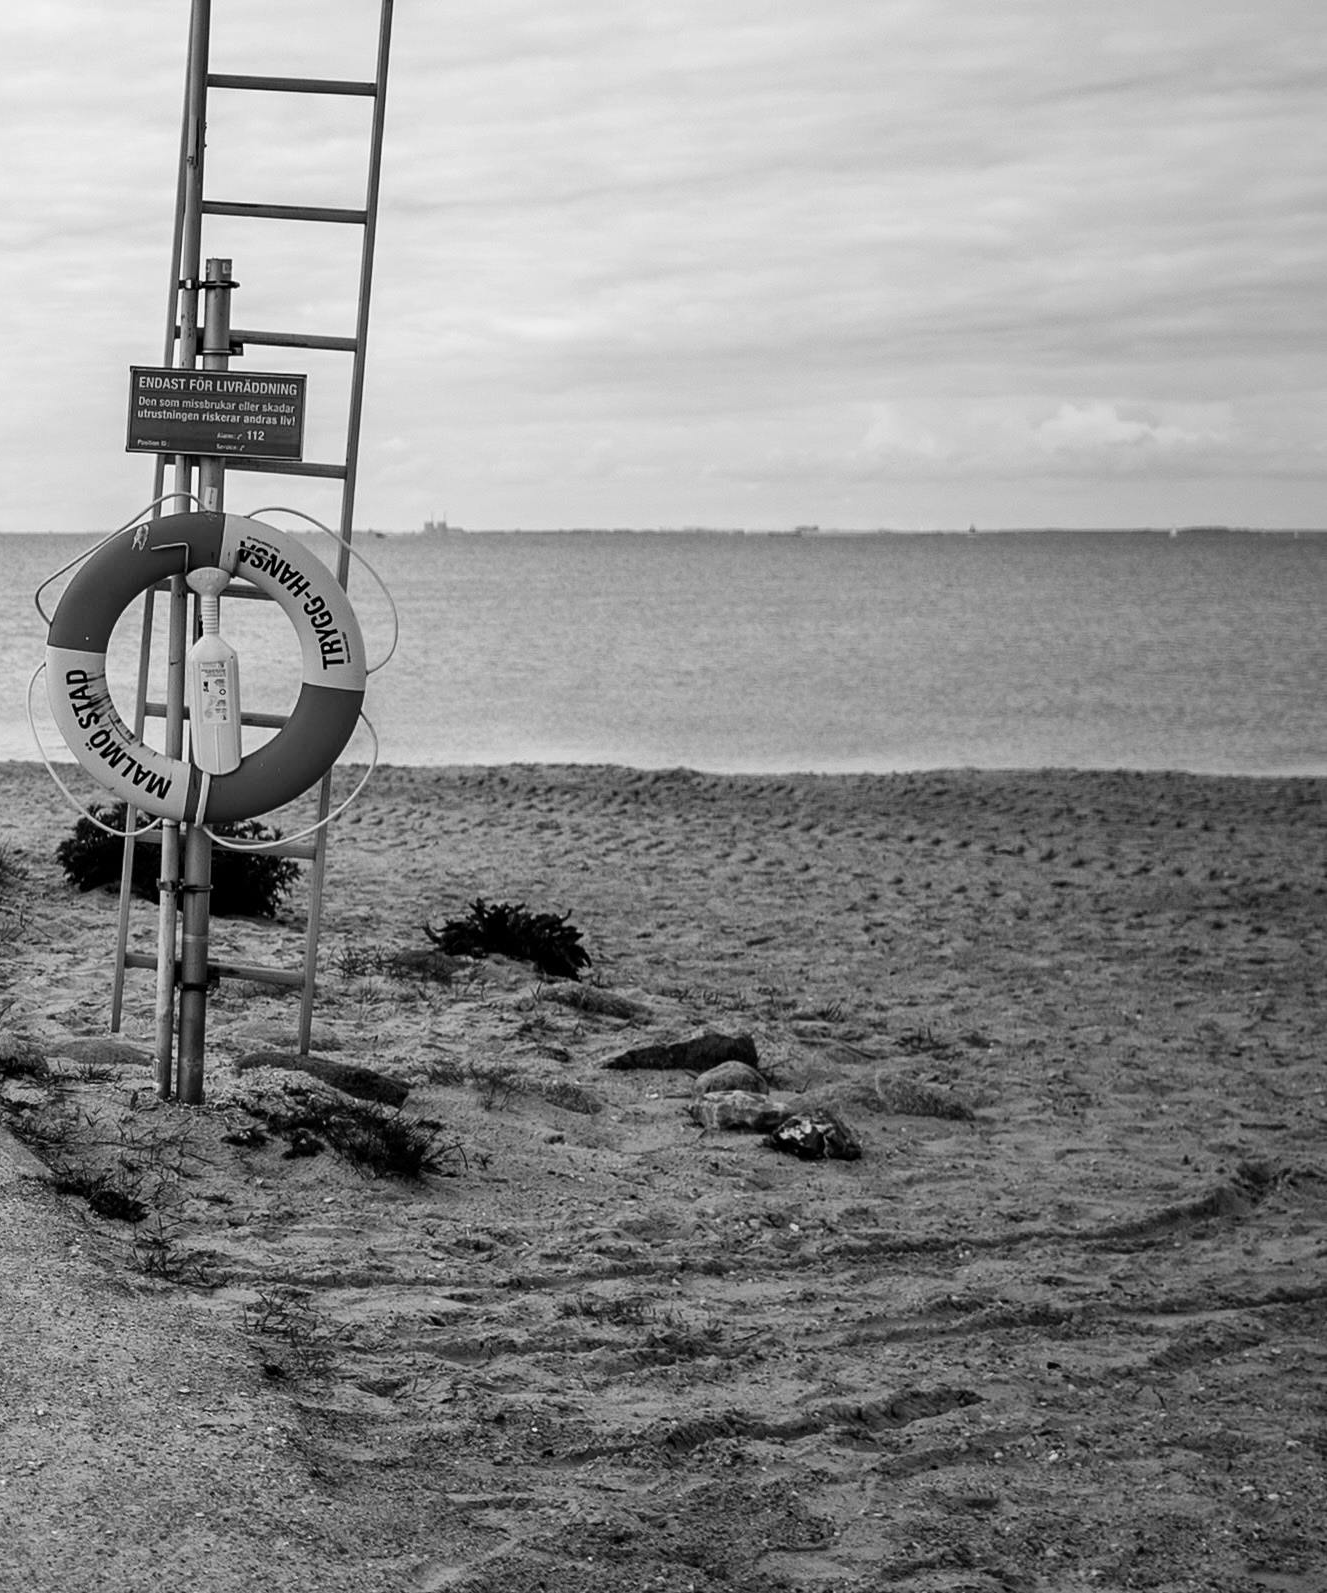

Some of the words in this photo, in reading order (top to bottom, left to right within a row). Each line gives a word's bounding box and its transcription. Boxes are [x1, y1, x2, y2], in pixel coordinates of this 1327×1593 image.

[139, 376, 186, 390] ENDAST
[189, 376, 213, 392] FÖR
[216, 379, 298, 396] LIVRÄDDNING
[138, 396, 157, 407] Den
[159, 398, 180, 408] som
[182, 398, 236, 411] missbrukar
[238, 402, 260, 412] eller
[261, 403, 296, 414] skadar
[137, 408, 200, 423] utrustningen
[202, 411, 241, 423] riskerar
[243, 414, 278, 426] andras
[280, 415, 296, 427] liv!
[246, 430, 266, 441] 112
[239, 540, 345, 670] TRYGG-HANSA
[66, 670, 100, 729] STAD
[85, 729, 172, 800] MALMÖ
